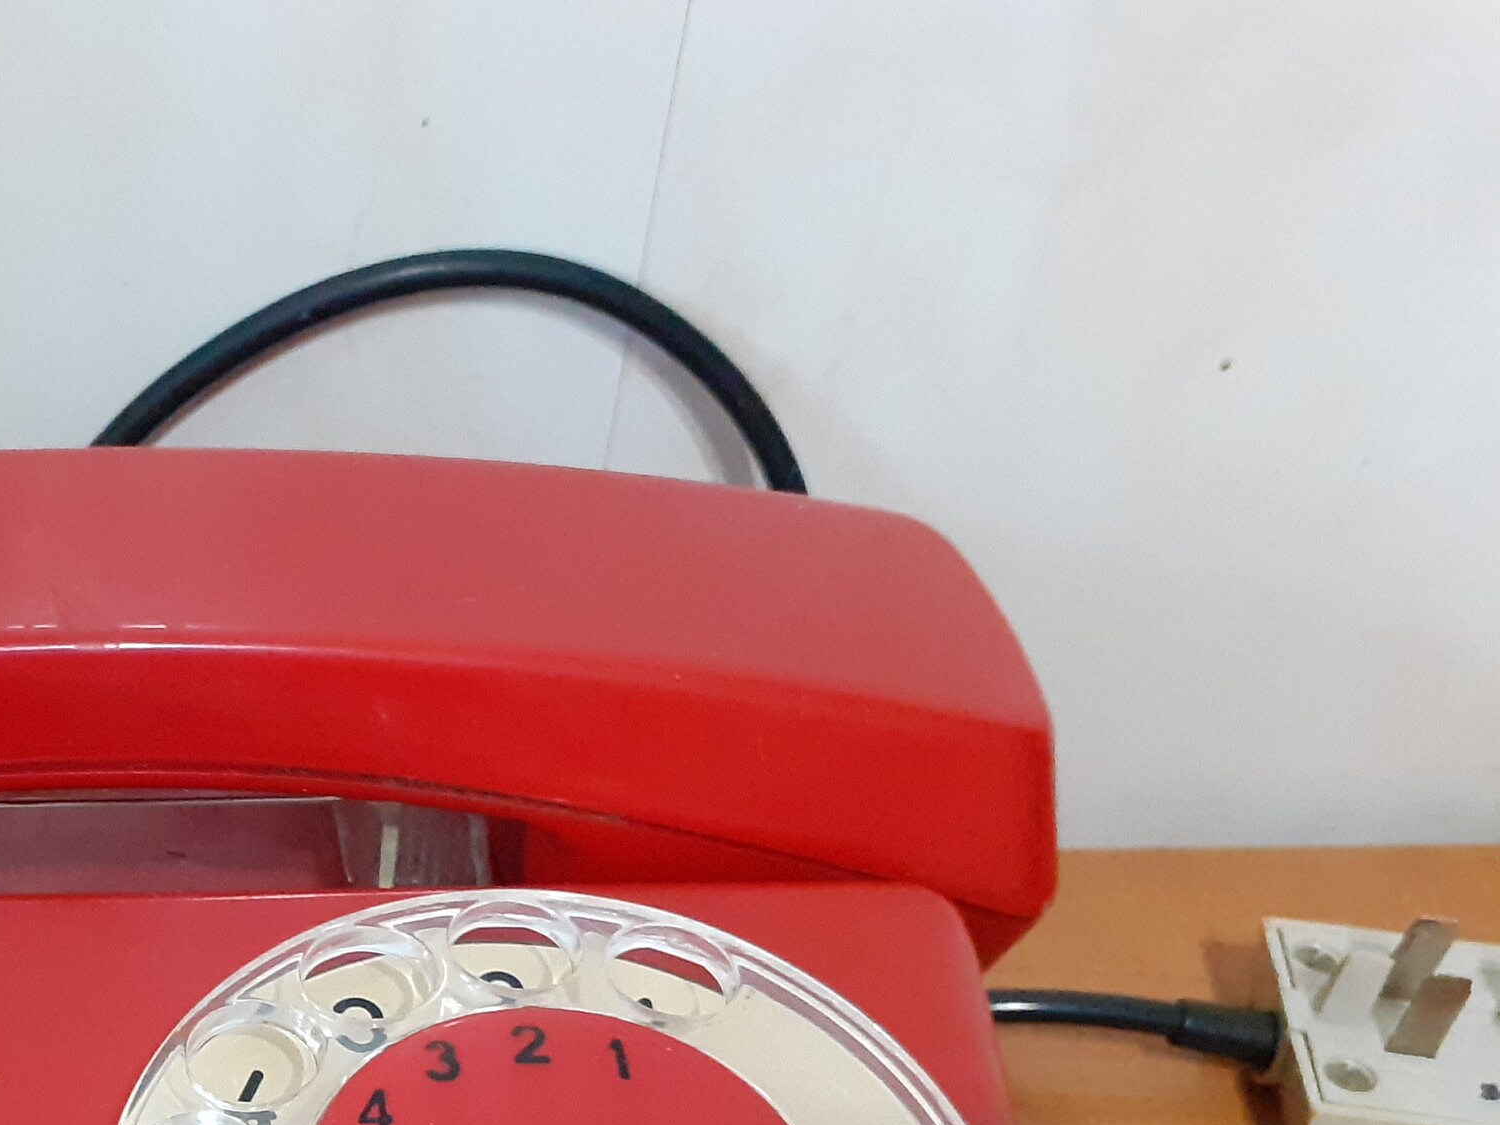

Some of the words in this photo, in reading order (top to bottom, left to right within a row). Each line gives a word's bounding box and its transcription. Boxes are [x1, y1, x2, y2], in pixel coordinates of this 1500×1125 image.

[426, 1041, 462, 1082] 3
[511, 1025, 552, 1065] 2
[609, 1038, 632, 1081] 1
